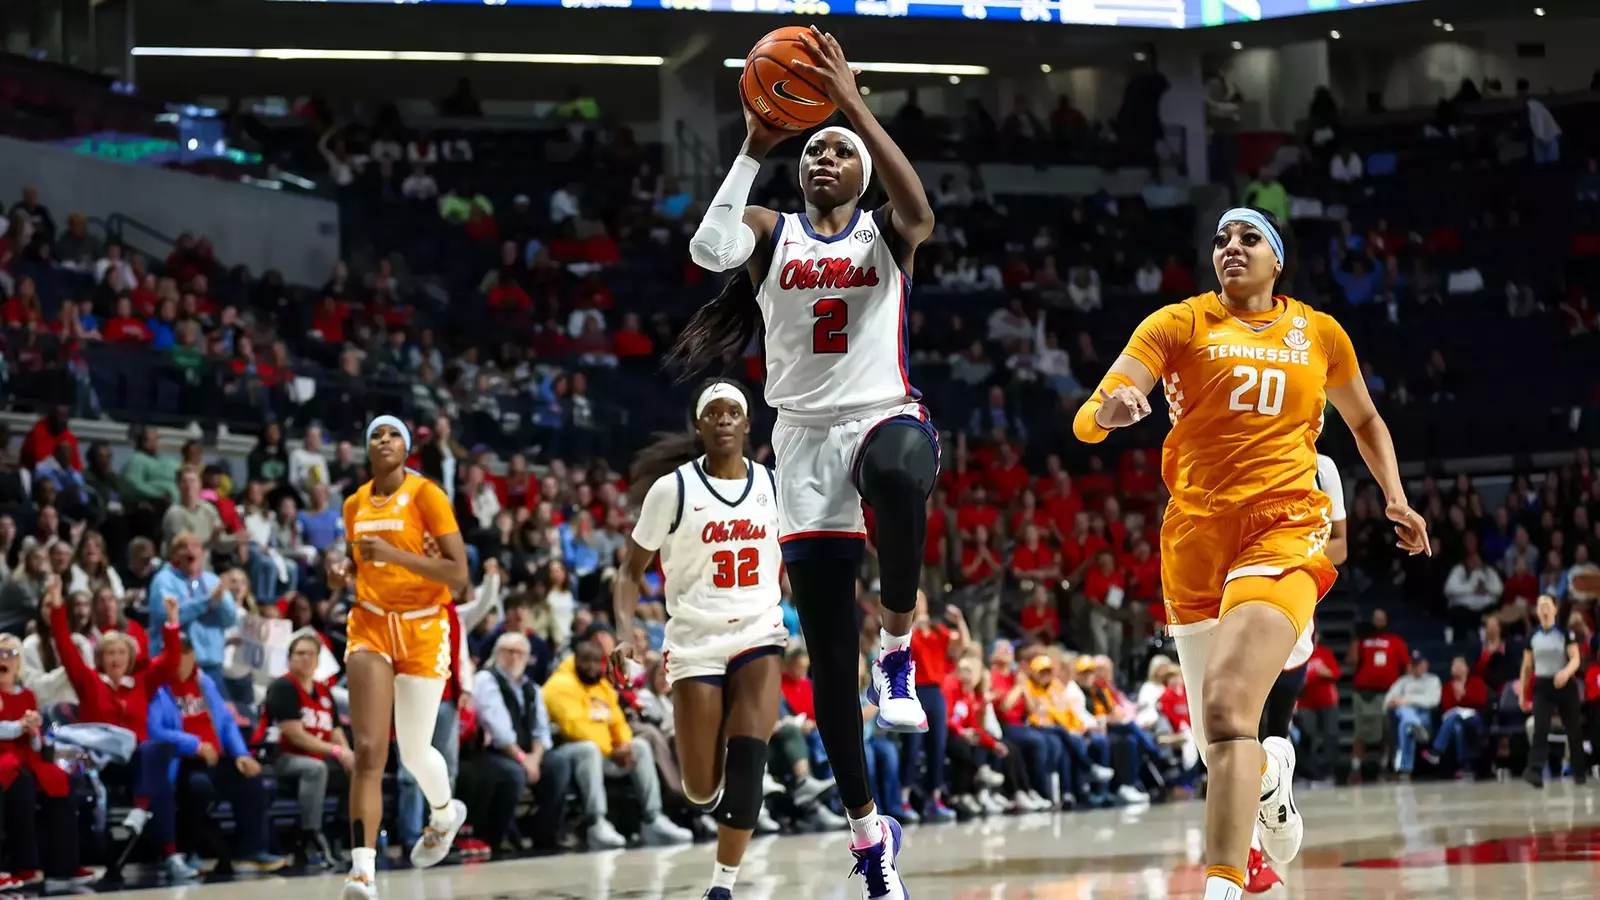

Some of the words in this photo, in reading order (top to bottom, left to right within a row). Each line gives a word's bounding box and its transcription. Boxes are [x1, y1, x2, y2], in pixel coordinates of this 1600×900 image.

[779, 258, 819, 291] Ole
[817, 257, 880, 289] Miss
[812, 298, 848, 354] 2
[1208, 344, 1310, 366] TENNESSEE
[1229, 365, 1287, 416] 20
[701, 520, 730, 544] Ole
[728, 519, 767, 541] Miss
[712, 547, 760, 589] 32
